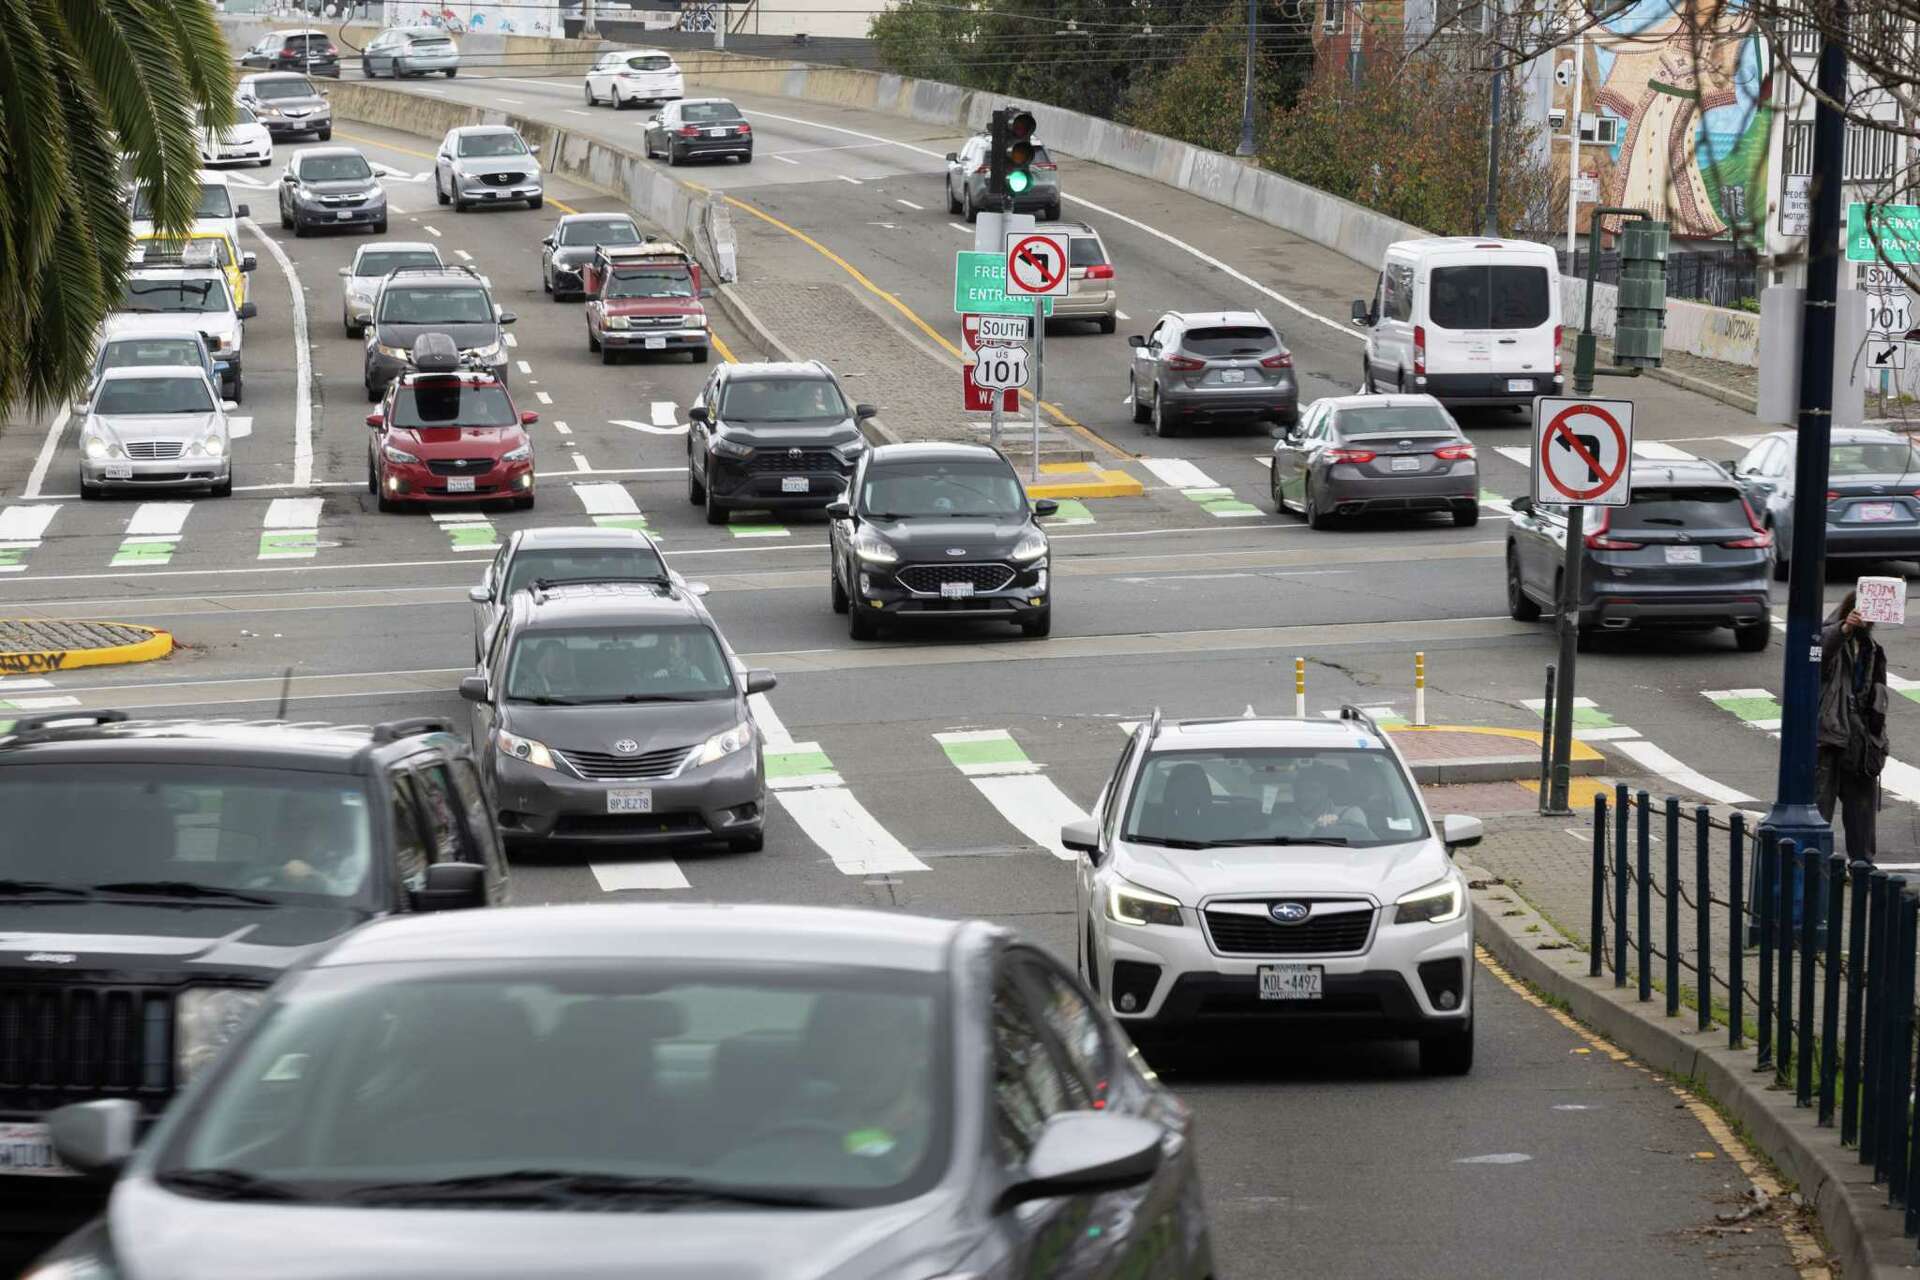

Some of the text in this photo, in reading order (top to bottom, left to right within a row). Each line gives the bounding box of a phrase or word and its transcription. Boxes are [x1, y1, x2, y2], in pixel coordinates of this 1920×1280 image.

[1864, 217, 1920, 229] REEWAY
[974, 265, 1006, 279] FREE
[1870, 307, 1903, 329] 101
[983, 320, 1025, 337] SOUTH
[996, 351, 1008, 359] US
[984, 361, 1020, 383] 101
[610, 798, 649, 809] 8PJE278
